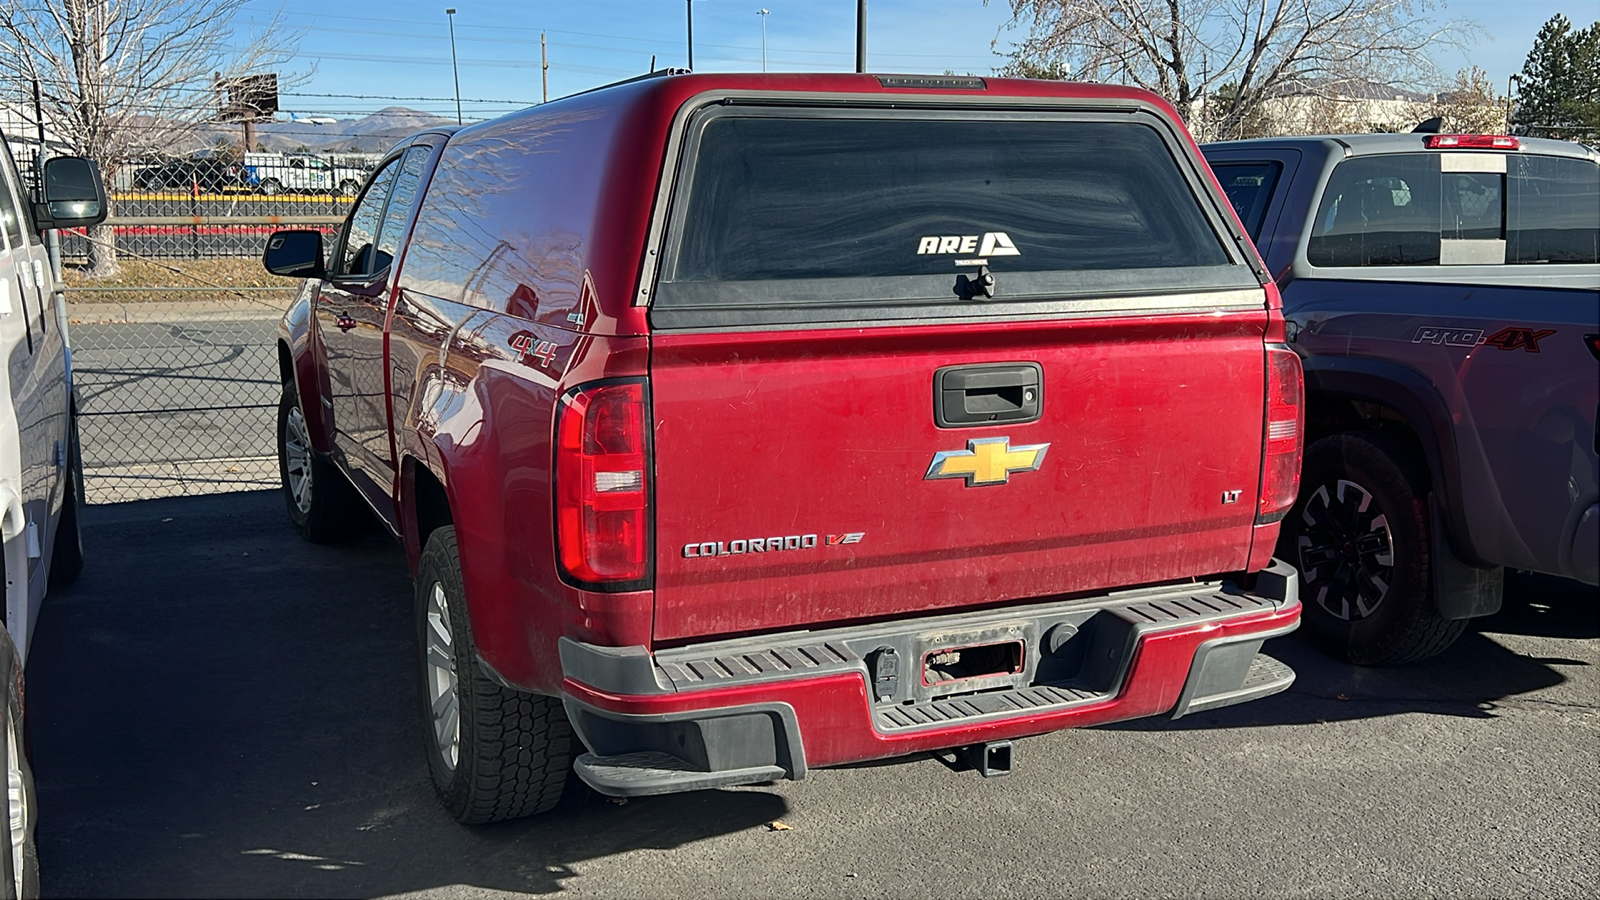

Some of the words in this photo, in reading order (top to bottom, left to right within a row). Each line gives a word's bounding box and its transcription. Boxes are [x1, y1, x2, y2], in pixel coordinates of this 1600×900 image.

[917, 235, 980, 254] ARE
[1222, 489, 1243, 505] LT
[682, 533, 818, 559] COLORADO
[825, 531, 866, 545] V6
